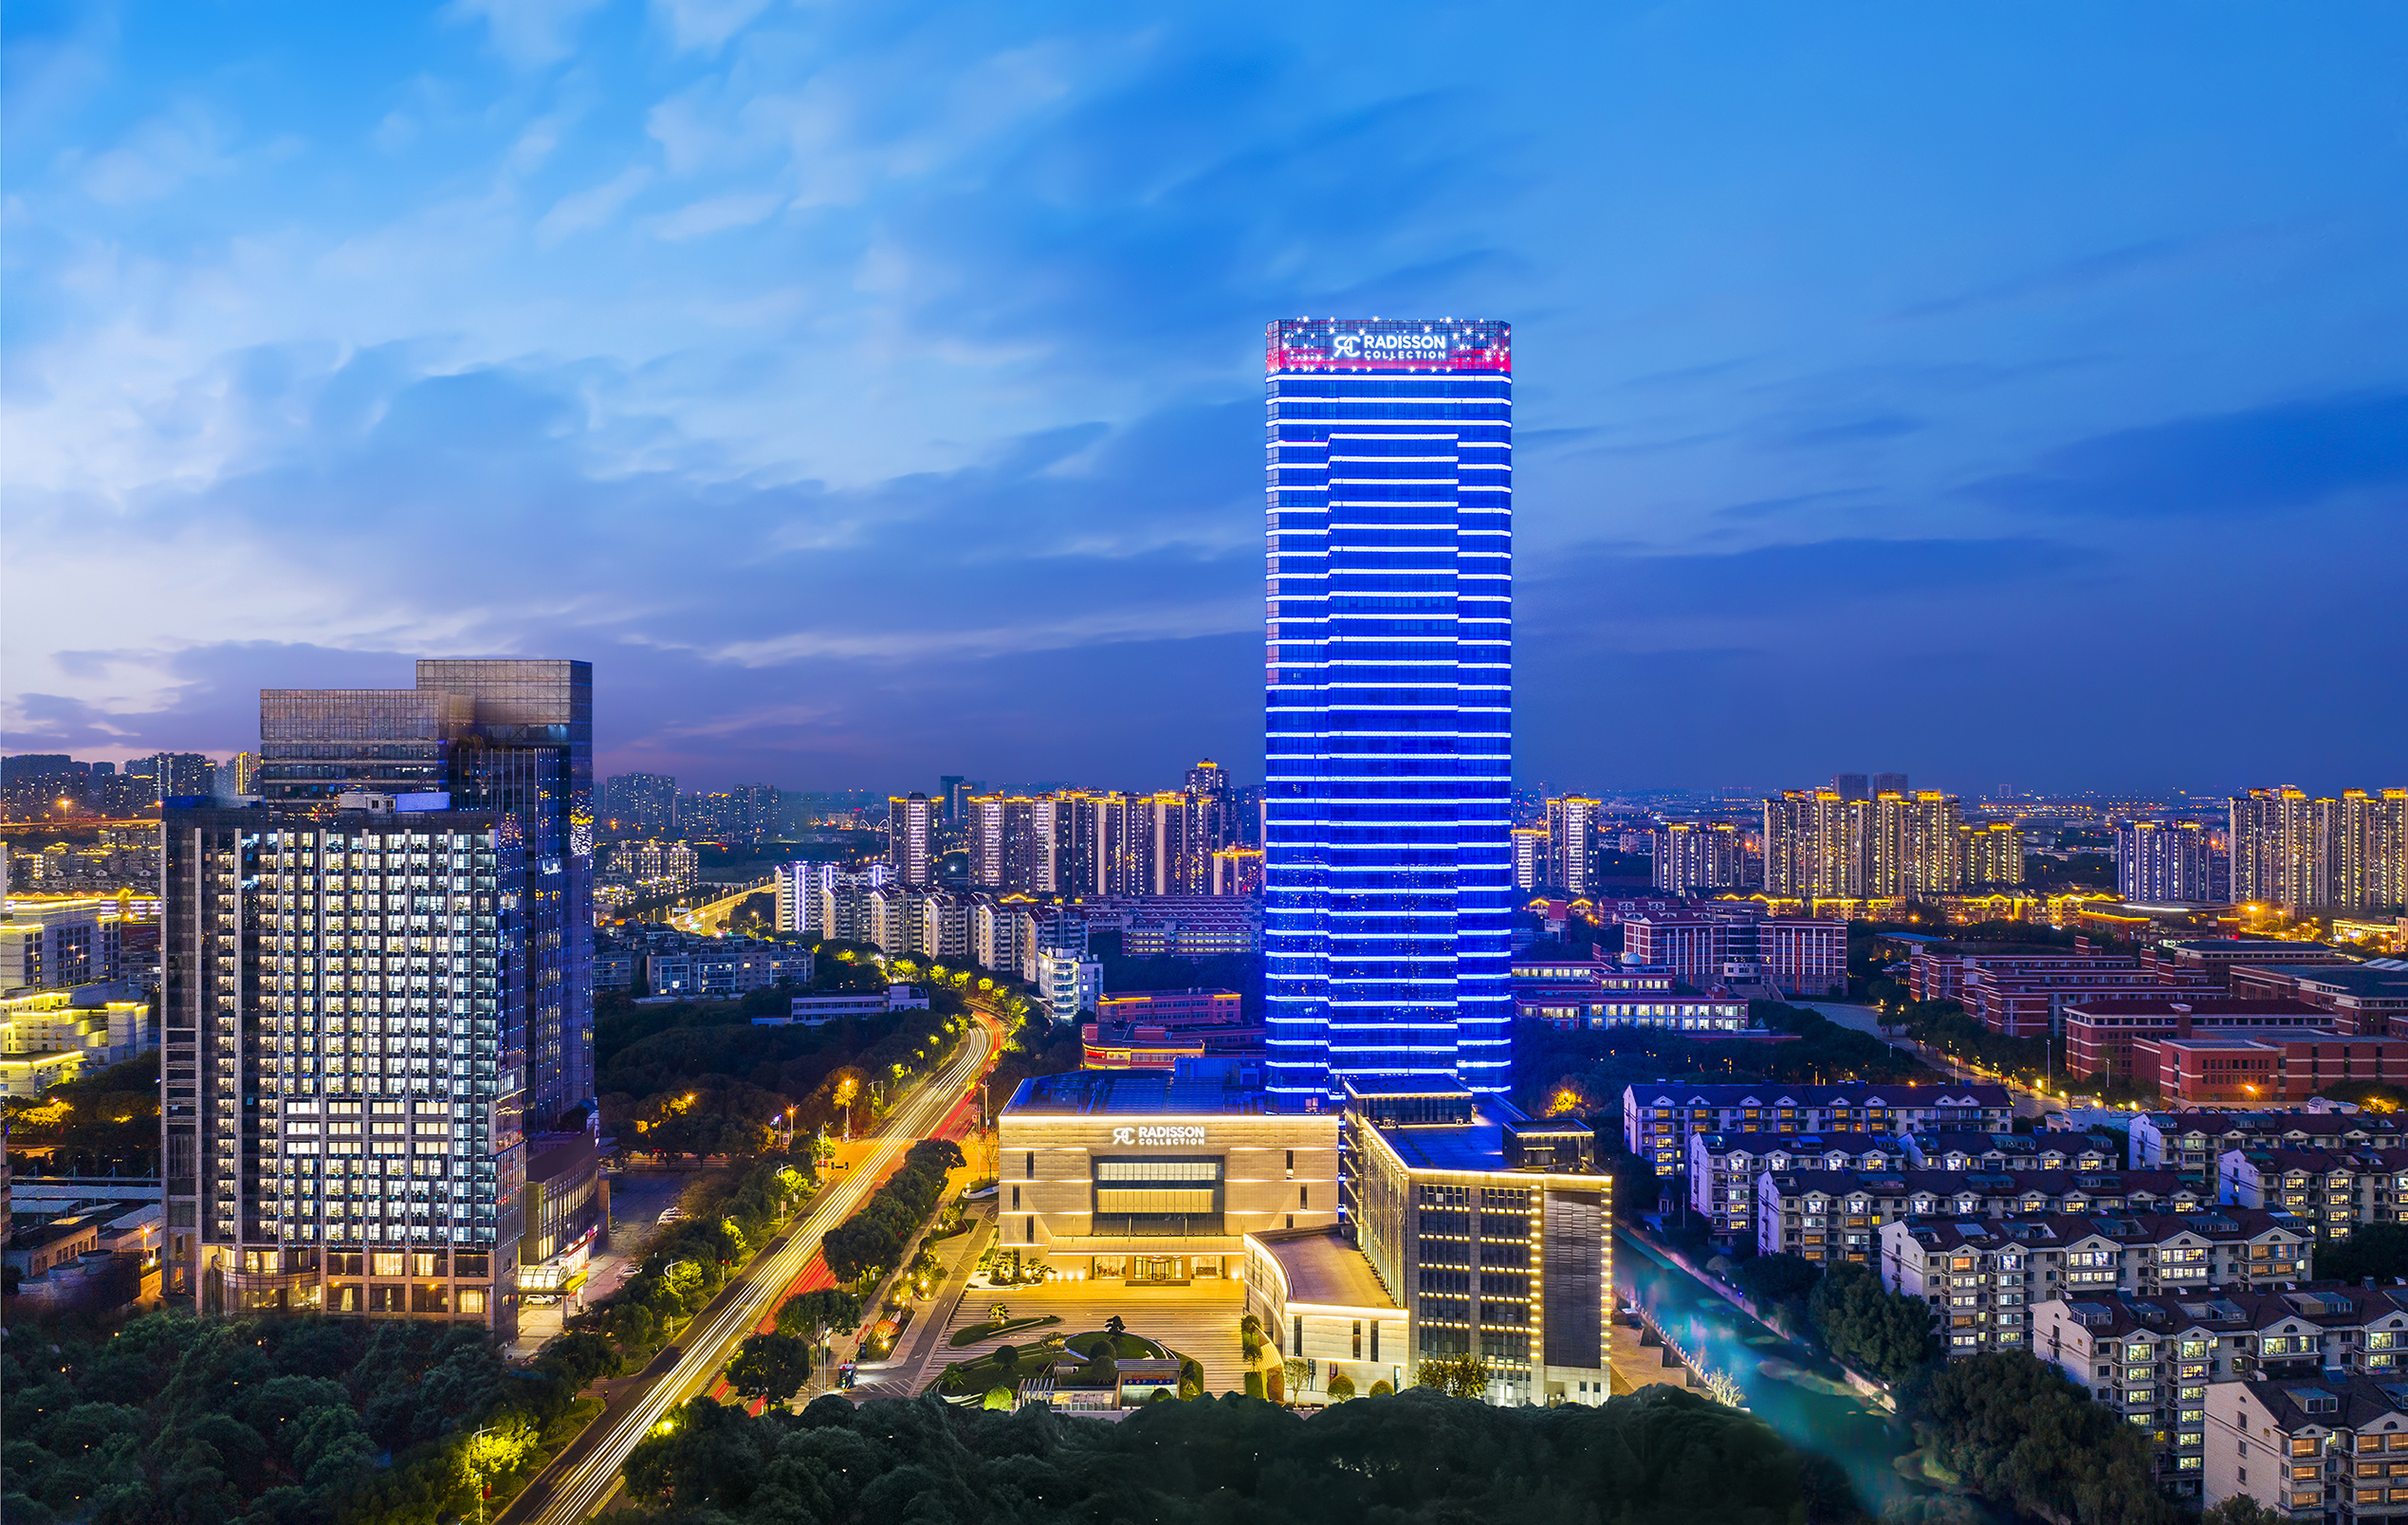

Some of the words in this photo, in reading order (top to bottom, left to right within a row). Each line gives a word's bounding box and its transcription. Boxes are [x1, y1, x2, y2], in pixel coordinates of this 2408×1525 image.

[1364, 335, 1445, 349] RADISSON
[1364, 350, 1445, 359] COLLECTION
[1138, 1126, 1204, 1138] RADISSON
